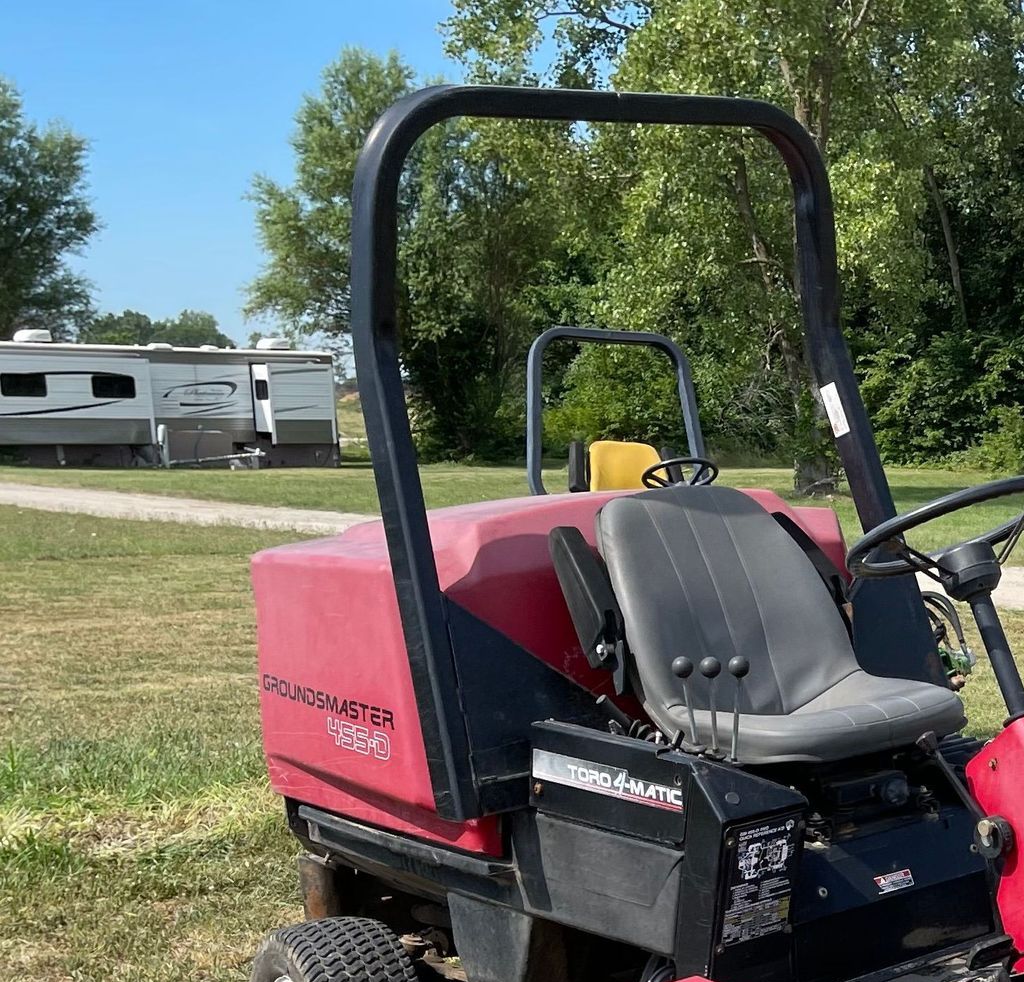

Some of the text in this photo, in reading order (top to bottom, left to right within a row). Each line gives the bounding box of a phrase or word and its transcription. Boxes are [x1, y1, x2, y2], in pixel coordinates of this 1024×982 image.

[263, 674, 395, 730] GROUNDSMASTER
[327, 717, 391, 760] 455-D
[567, 765, 683, 806] TORO 4-MATIC
